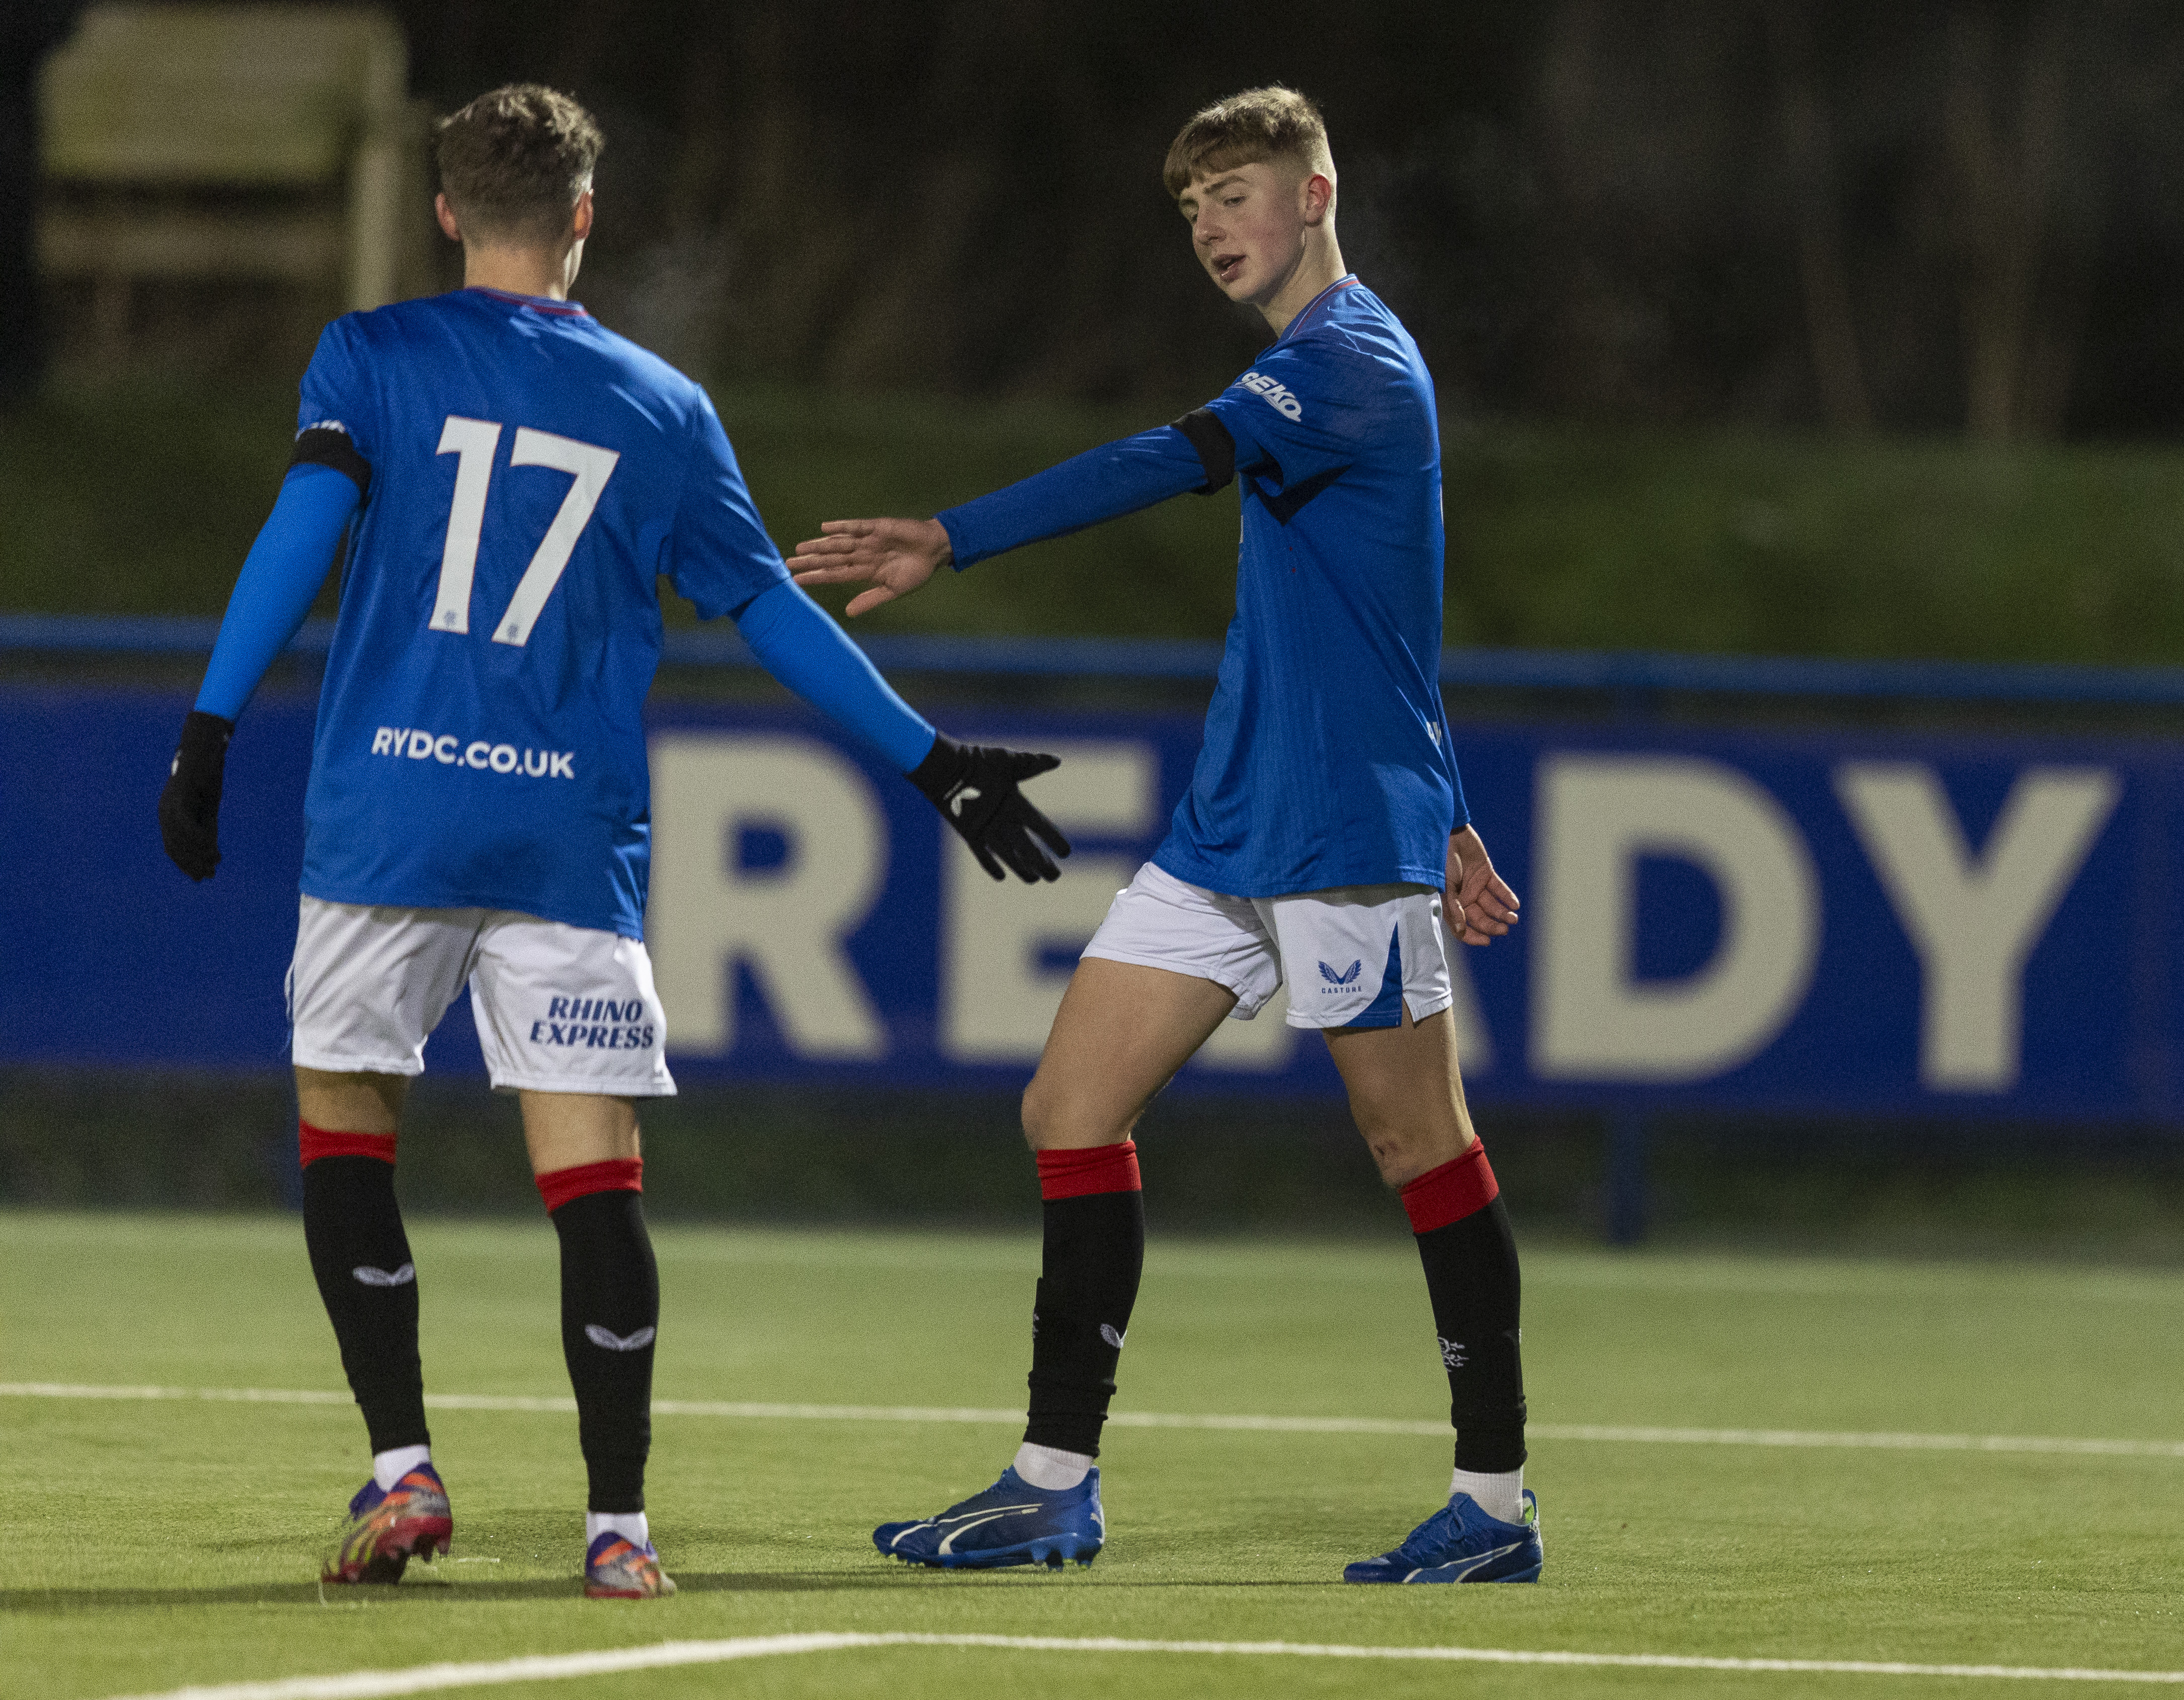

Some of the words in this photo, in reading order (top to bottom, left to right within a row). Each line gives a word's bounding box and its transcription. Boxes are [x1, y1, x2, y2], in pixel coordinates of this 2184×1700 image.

[428, 415, 621, 648] 17
[371, 726, 576, 780] RYDC.CO.UK
[649, 730, 2126, 1096] REDY
[529, 1020, 654, 1050] EXPRESS
[548, 995, 644, 1023] RHINO
